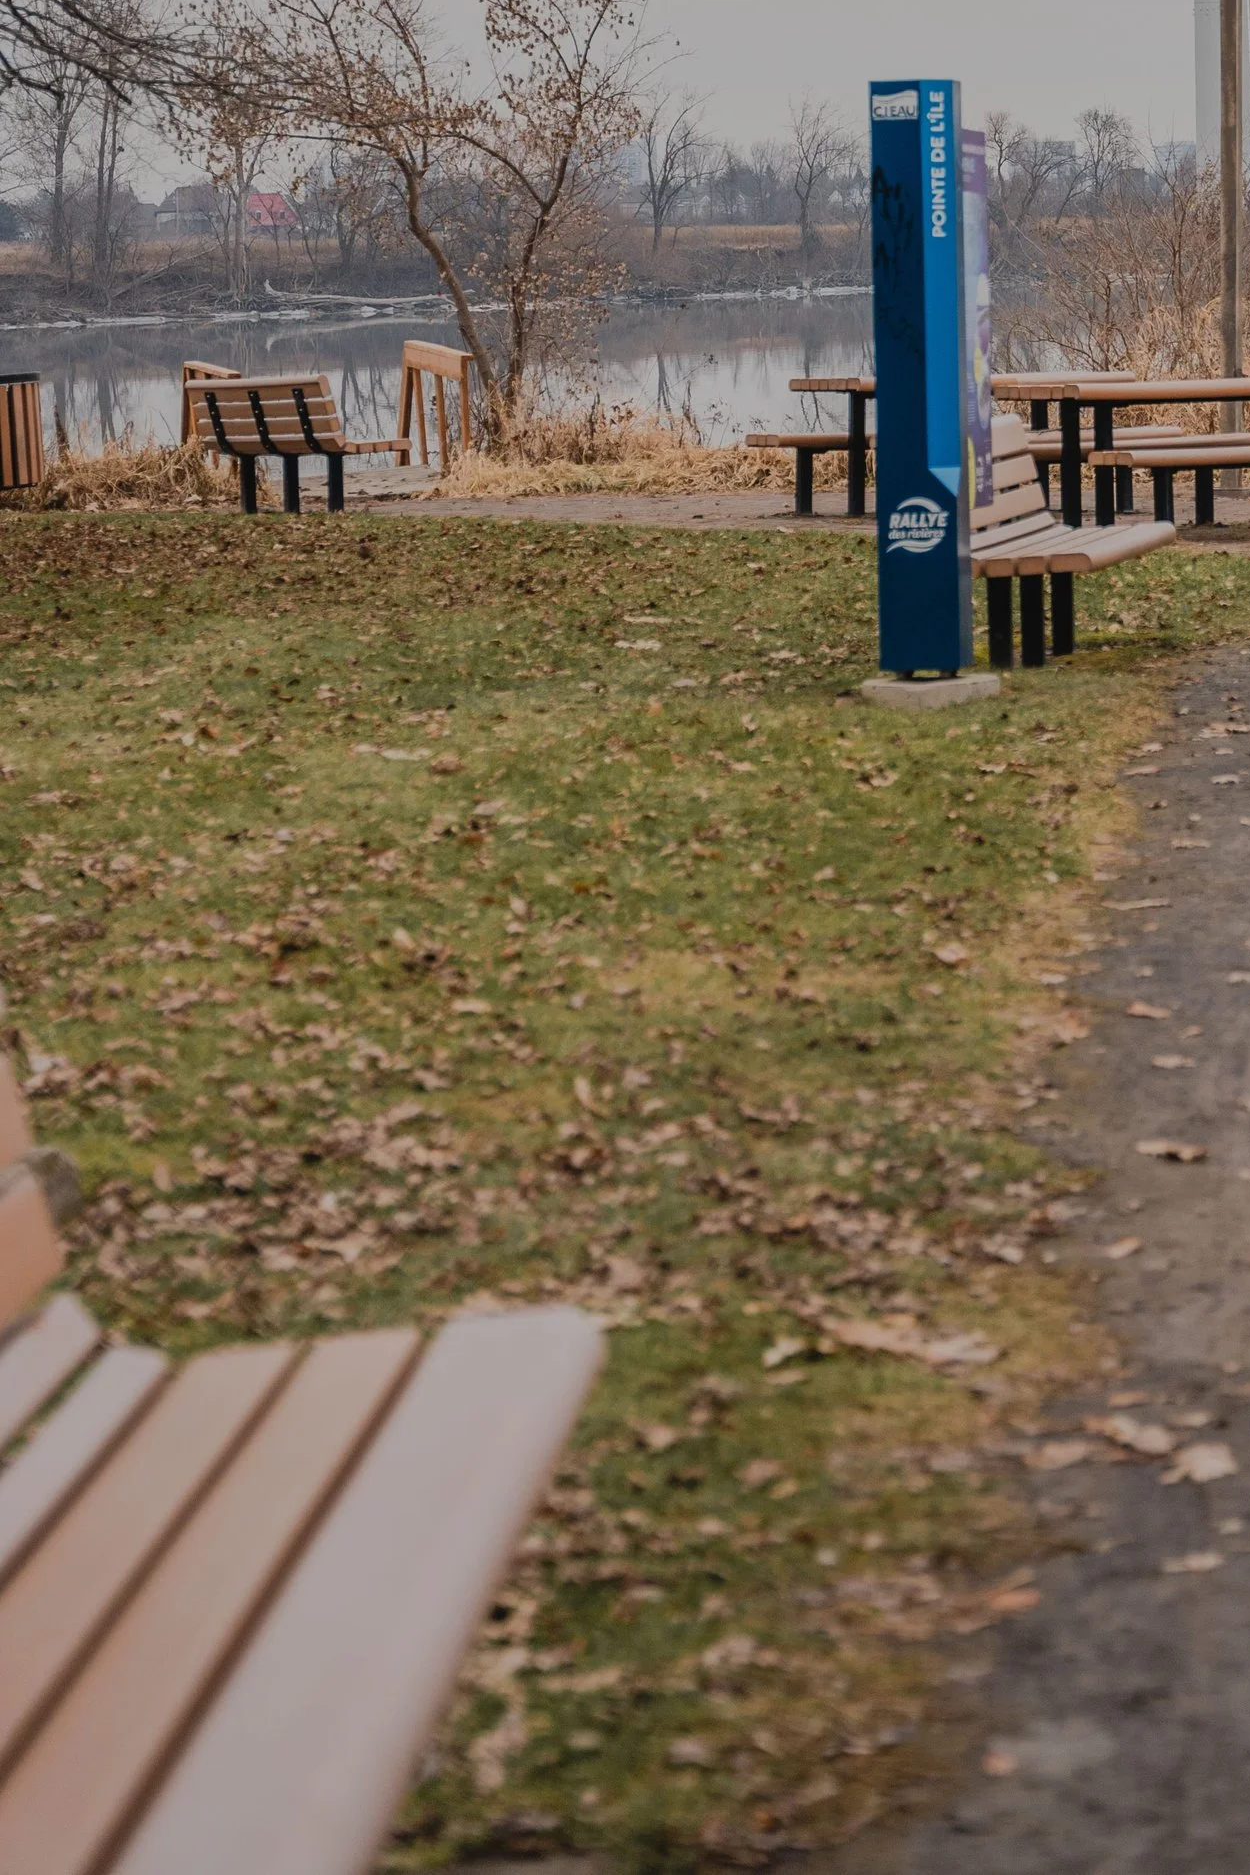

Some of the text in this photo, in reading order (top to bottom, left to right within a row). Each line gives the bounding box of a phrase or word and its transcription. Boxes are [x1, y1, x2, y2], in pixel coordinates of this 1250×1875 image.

[930, 136, 946, 162] DE
[931, 167, 948, 238] POINTE
[889, 512, 948, 529] RALLYE
[888, 529, 906, 539] des
